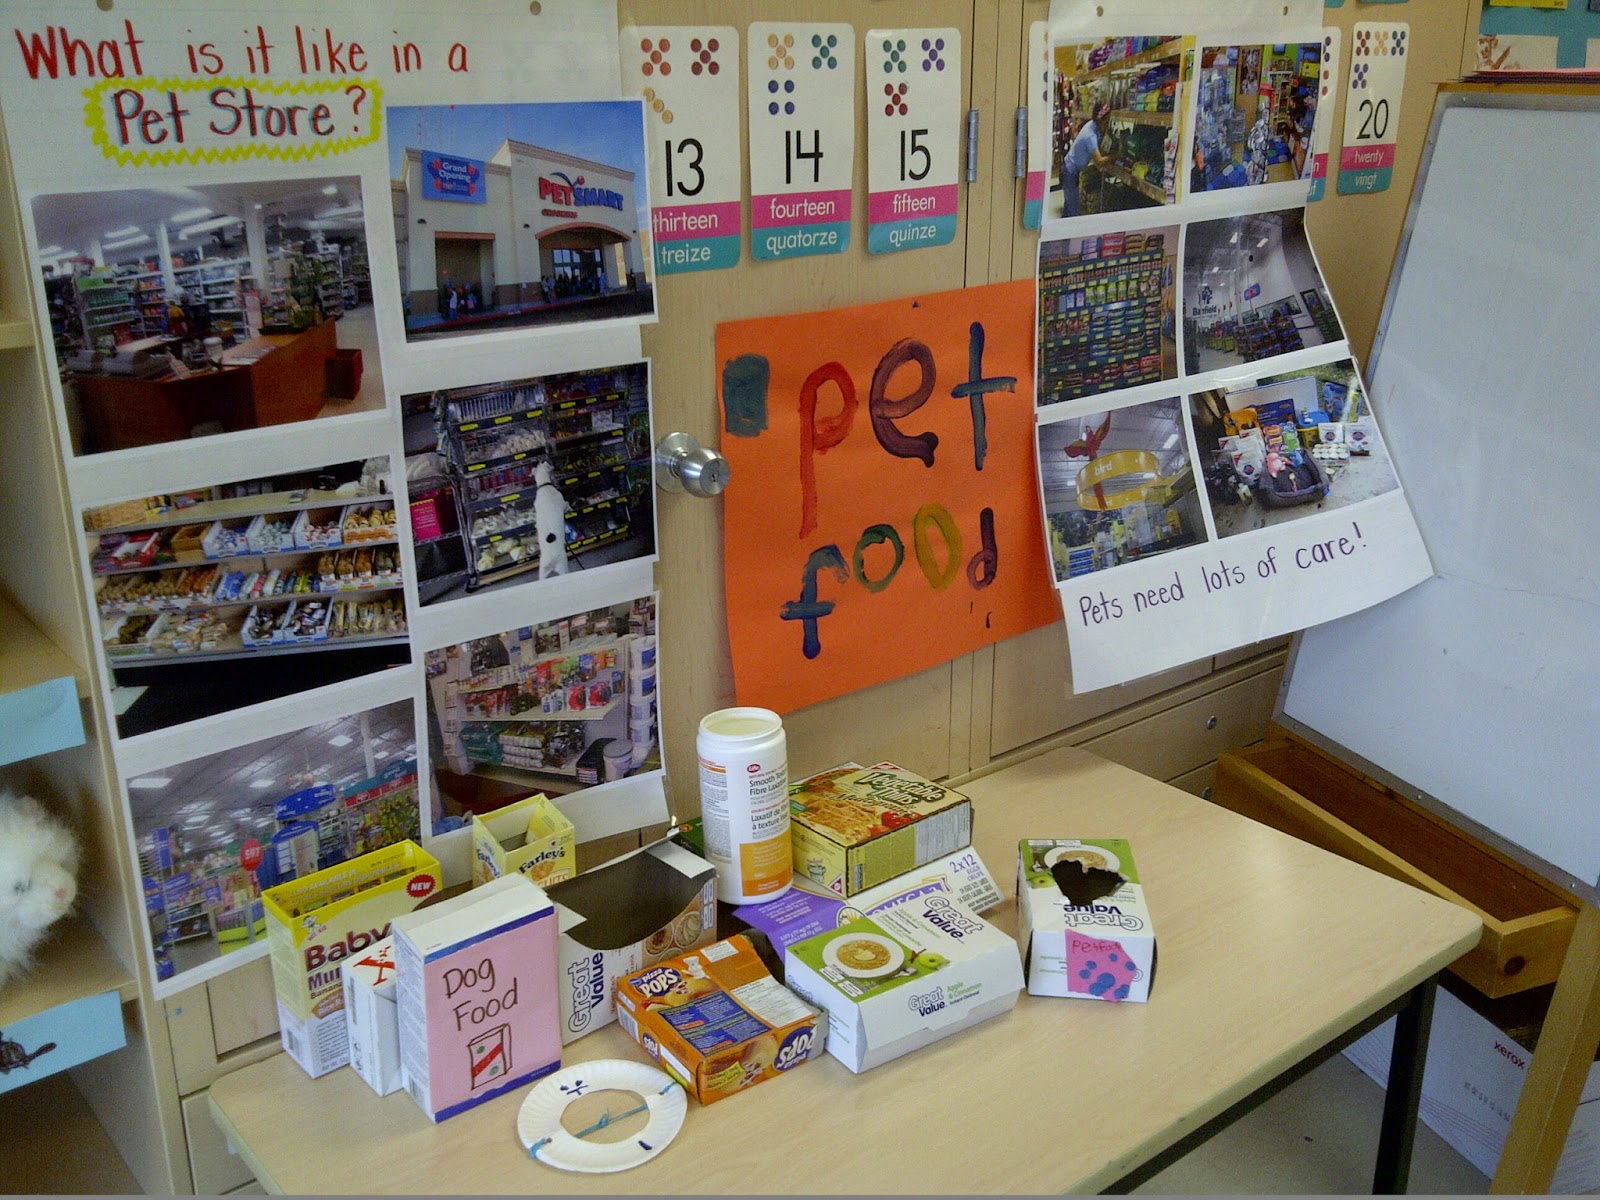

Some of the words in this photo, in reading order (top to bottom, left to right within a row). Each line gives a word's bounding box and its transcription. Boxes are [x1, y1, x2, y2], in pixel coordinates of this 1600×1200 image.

[14, 20, 144, 80] What
[187, 30, 224, 76] is
[246, 28, 274, 75] it
[296, 27, 368, 73] like
[393, 30, 422, 72] in
[448, 41, 469, 73] a
[112, 89, 190, 148] Pet
[1356, 98, 1389, 140] 20
[442, 161, 468, 174] Grand
[664, 138, 705, 197] 13
[785, 129, 824, 184] 14
[900, 128, 931, 181] 15
[1354, 149, 1384, 166] twenty
[438, 169, 471, 184] Opening
[1355, 171, 1377, 190] vingt
[769, 199, 836, 221] fourteen
[892, 193, 936, 213] fifteen
[652, 211, 719, 234] thirteen
[889, 222, 937, 247] quinze
[660, 243, 711, 266] treize
[765, 229, 838, 255] quatorze
[1079, 594, 1125, 629] Pets
[1133, 573, 1184, 615] need
[1200, 561, 1248, 595] lots
[1256, 537, 1278, 579] of
[1295, 520, 1367, 573] care!
[749, 775, 775, 788] Smooth
[750, 786, 768, 796] Fibre
[854, 772, 946, 802] Vegetable
[751, 811, 773, 822] Laxatif
[758, 817, 780, 829] texture
[519, 847, 566, 874] Farley's
[950, 854, 977, 873] 2x12
[410, 881, 431, 891] NEW
[924, 896, 985, 935] Great
[1063, 904, 1122, 915] Value
[1064, 913, 1144, 931] Great
[922, 910, 964, 939] Value
[305, 922, 392, 971] Baby
[442, 958, 496, 999] Dog
[590, 951, 604, 1009] Value
[640, 969, 680, 998] POPS
[453, 977, 518, 1031] Food
[568, 957, 591, 1032] Great
[908, 986, 944, 1011] Great
[918, 1001, 946, 1017] Value
[776, 1025, 817, 1068] POPS
[1493, 1041, 1526, 1070] xerox
